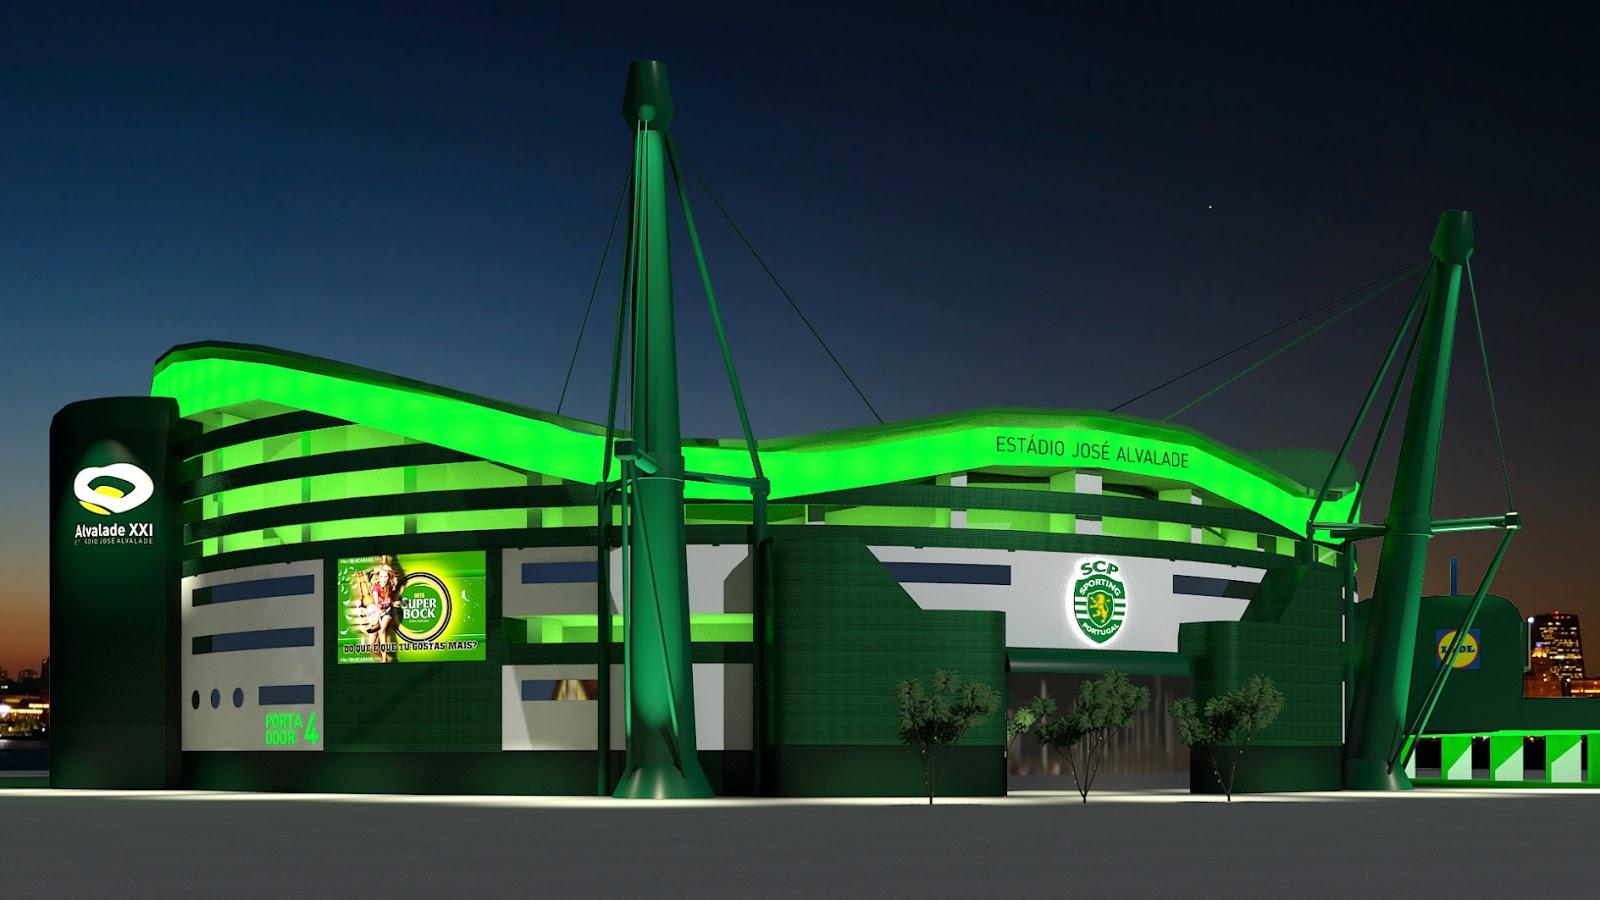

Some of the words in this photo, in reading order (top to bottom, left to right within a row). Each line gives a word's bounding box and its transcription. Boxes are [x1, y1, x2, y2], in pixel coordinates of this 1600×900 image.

[996, 434, 1065, 457] ESTÁDIO
[1072, 441, 1110, 461] JOSÉ
[1116, 446, 1189, 468] ALVALADE
[74, 523, 126, 538] Alvalade
[128, 523, 153, 537] XXI
[1080, 560, 1119, 576] SCP
[1079, 578, 1121, 597] SPORTING
[401, 597, 437, 609] SUPER
[403, 608, 436, 619] BOCK
[1082, 622, 1120, 635] PORTUGAL
[343, 644, 354, 653] DO
[355, 643, 371, 654] QUE
[380, 642, 397, 653] QUE
[398, 642, 410, 652] TU
[412, 641, 446, 651] GOSTAS
[448, 641, 478, 650] MAIS?
[1441, 645, 1476, 653] LDL
[265, 712, 304, 728] PORTA
[303, 711, 320, 745] 4
[265, 730, 297, 745] DOOR
